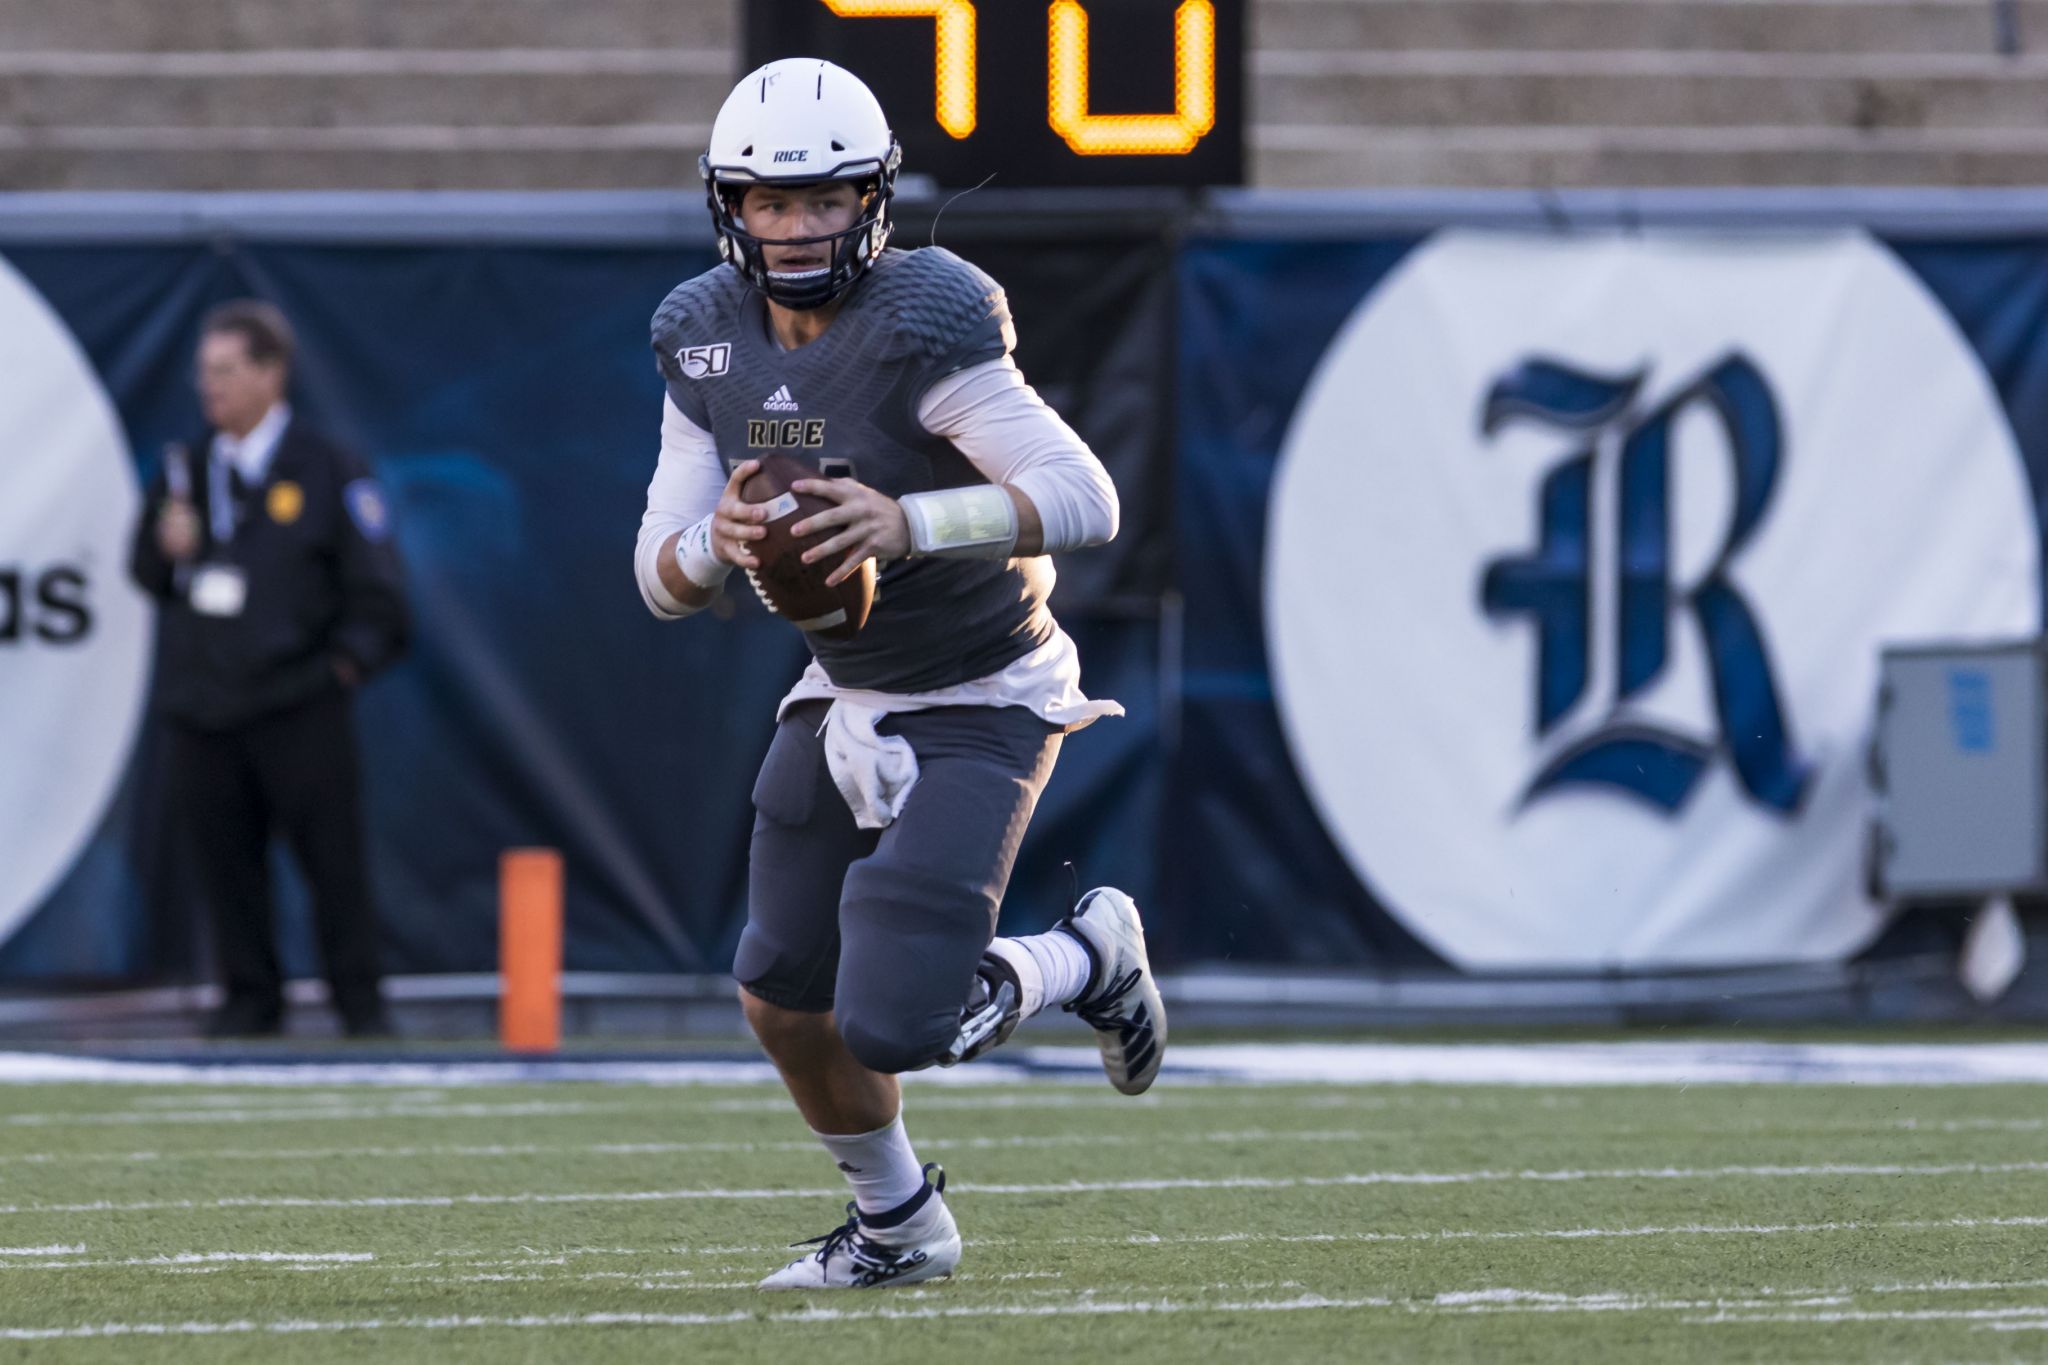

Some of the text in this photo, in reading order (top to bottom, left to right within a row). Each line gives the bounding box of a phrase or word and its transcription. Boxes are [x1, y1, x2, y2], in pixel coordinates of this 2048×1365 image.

[773, 150, 808, 163] RICE
[674, 343, 732, 379] 150
[763, 401, 799, 411] adidas
[747, 419, 826, 448] RICE
[0, 566, 92, 646] s
